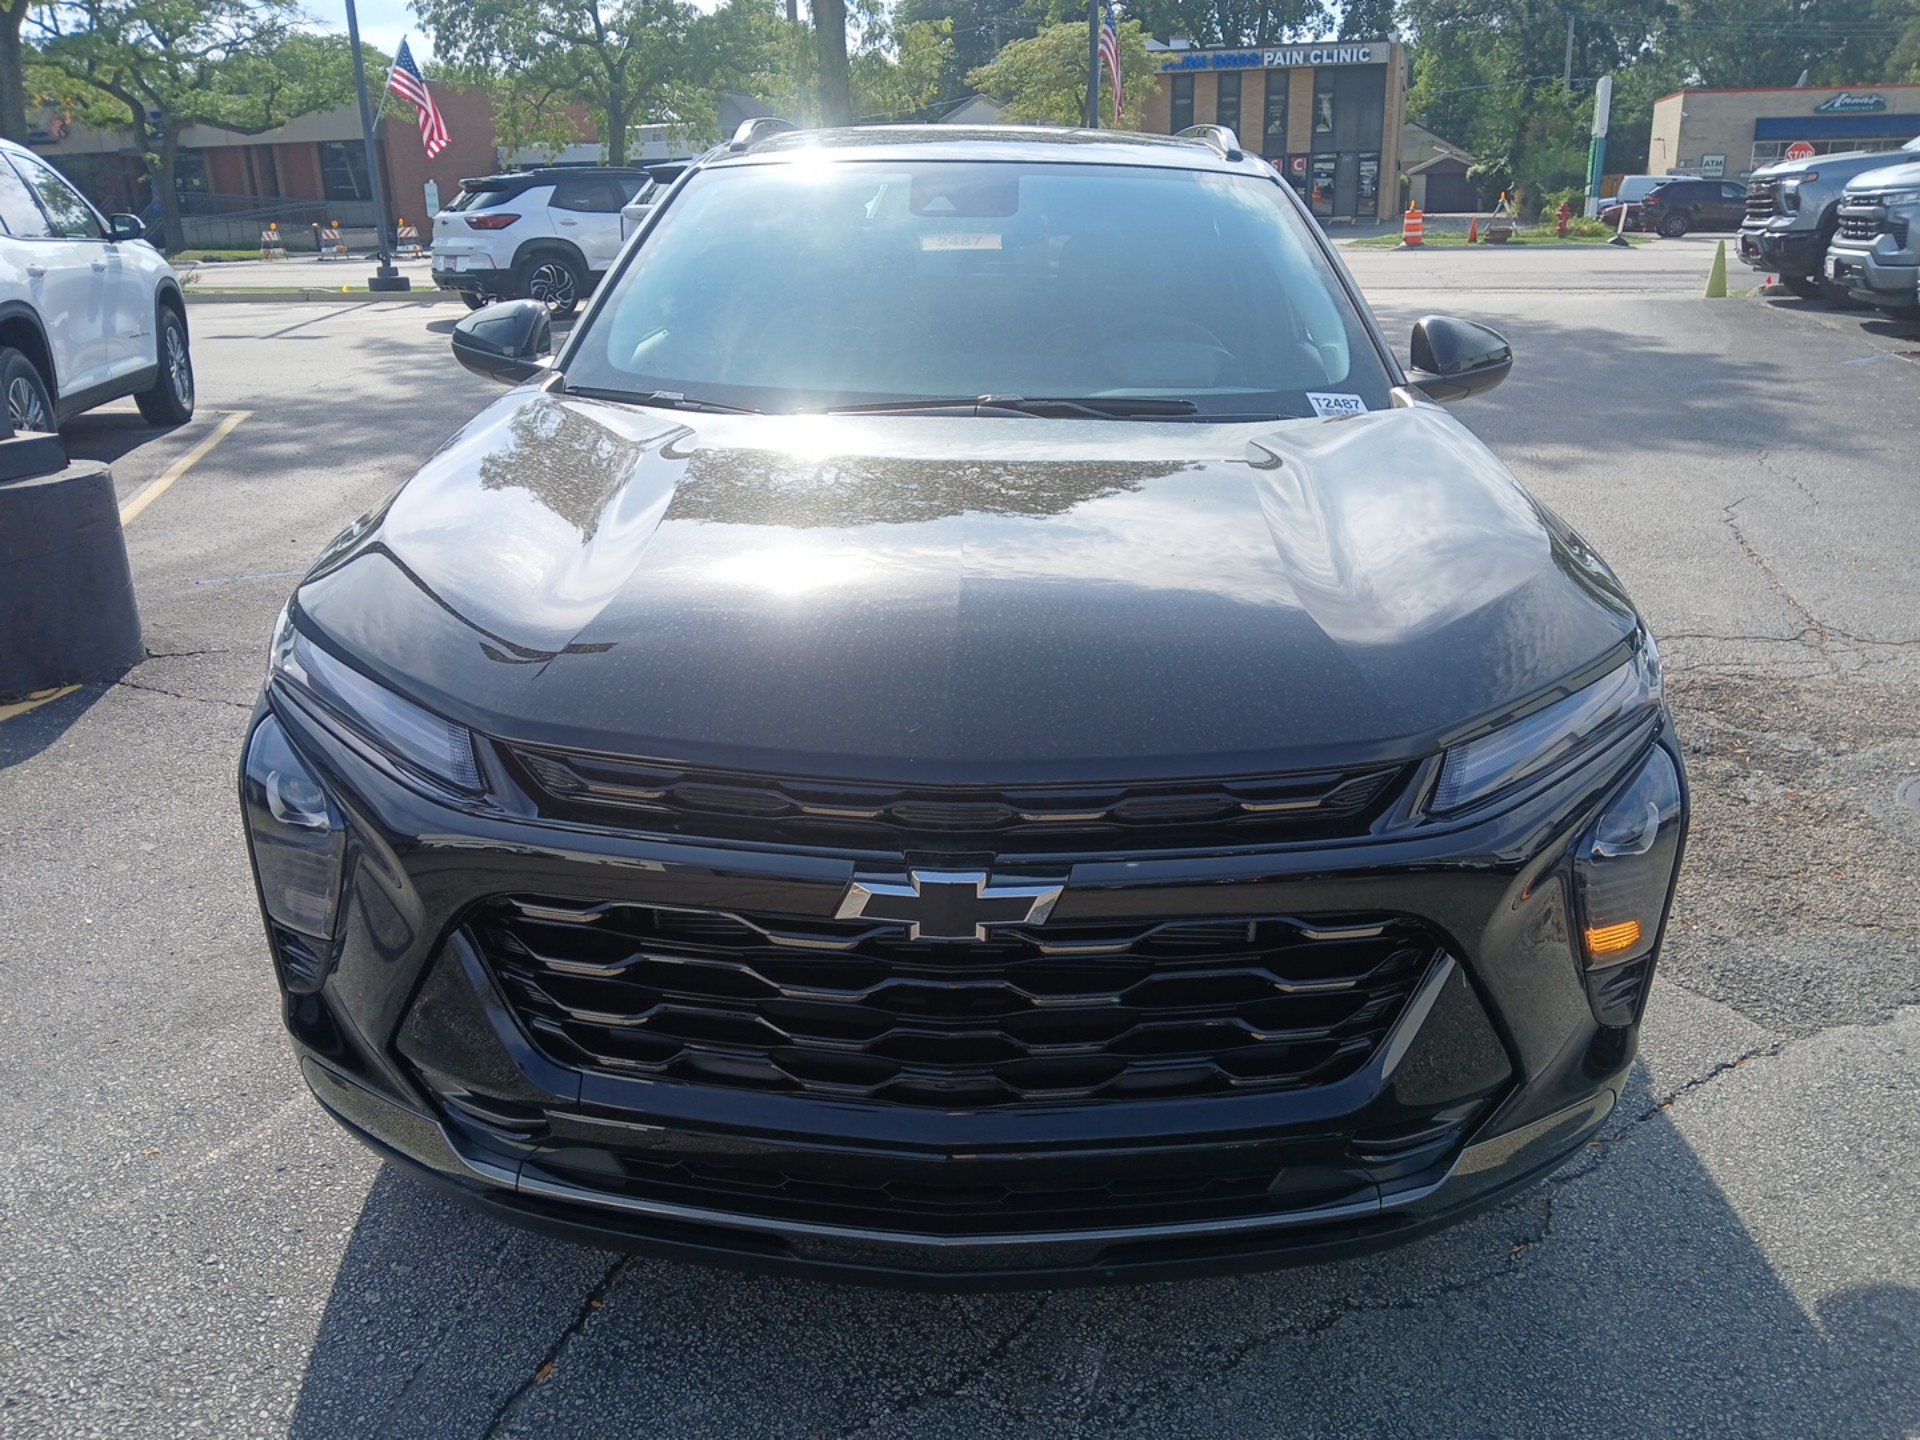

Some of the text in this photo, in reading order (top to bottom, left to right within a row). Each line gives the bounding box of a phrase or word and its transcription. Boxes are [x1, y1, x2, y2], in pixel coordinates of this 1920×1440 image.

[1263, 51, 1304, 66] PAIN
[1309, 47, 1371, 64] CLINIC
[1787, 150, 1813, 161] STOP
[1311, 397, 1359, 409] T2487
